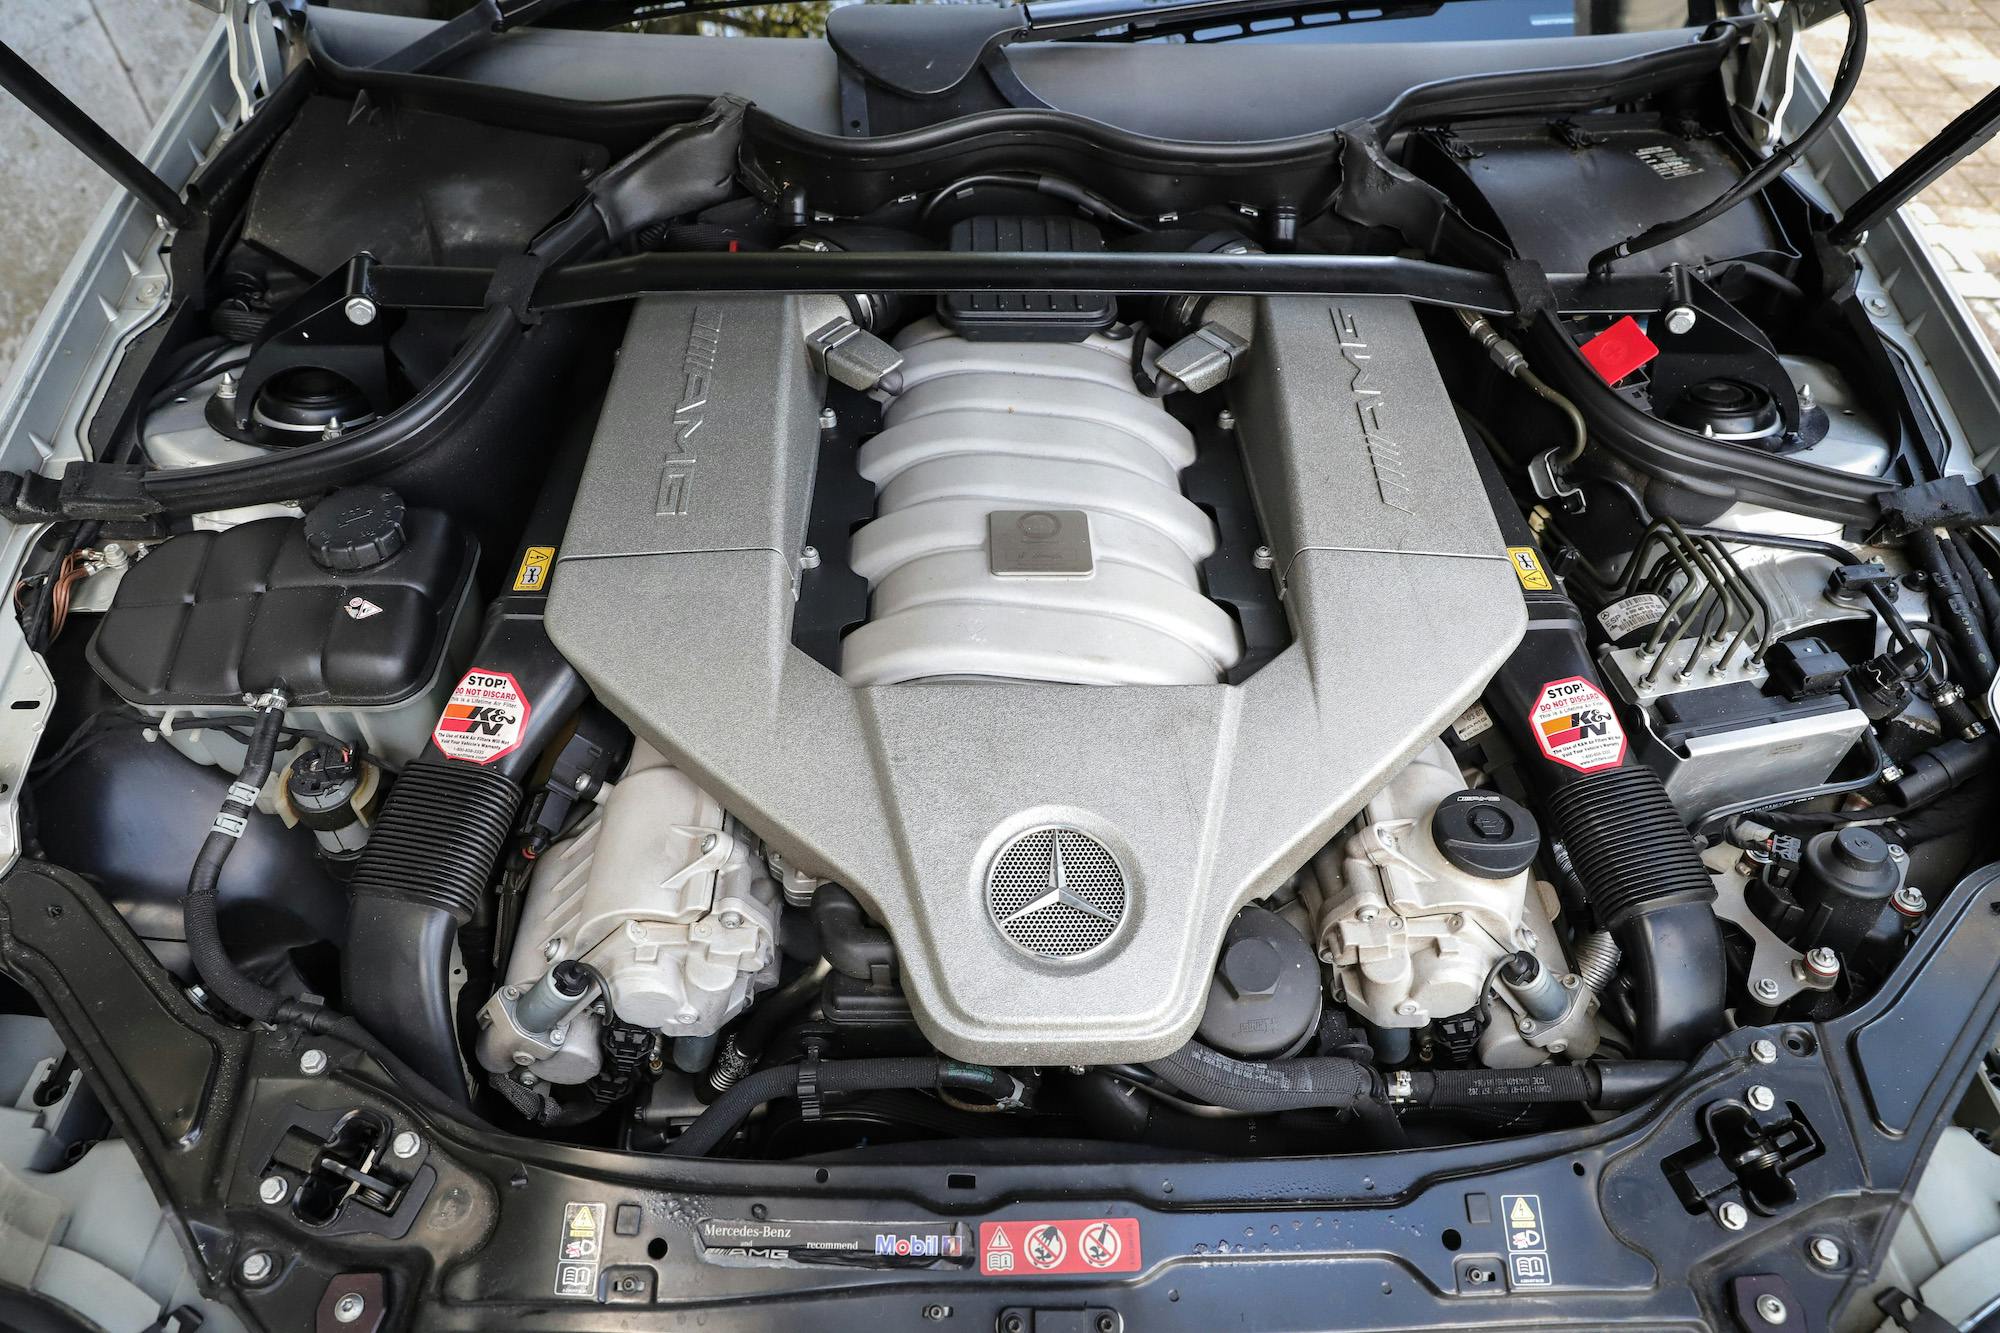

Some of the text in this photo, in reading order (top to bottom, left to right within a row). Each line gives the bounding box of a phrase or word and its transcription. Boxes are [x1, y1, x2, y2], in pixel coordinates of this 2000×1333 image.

[1605, 614, 1621, 628] ESP
[468, 675, 507, 689] STOP!
[465, 687, 482, 696] NOT
[482, 689, 517, 701] DISCARD
[1547, 683, 1585, 699] STOP!
[1540, 692, 1600, 712] DO NOT DISCARD
[466, 706, 516, 736] K&N
[1571, 709, 1611, 739] K&N
[704, 1224, 792, 1238] Mercedes-Benz
[806, 1241, 859, 1250] recommend
[875, 1234, 939, 1256] Mobil
[727, 1248, 790, 1259] AMG
